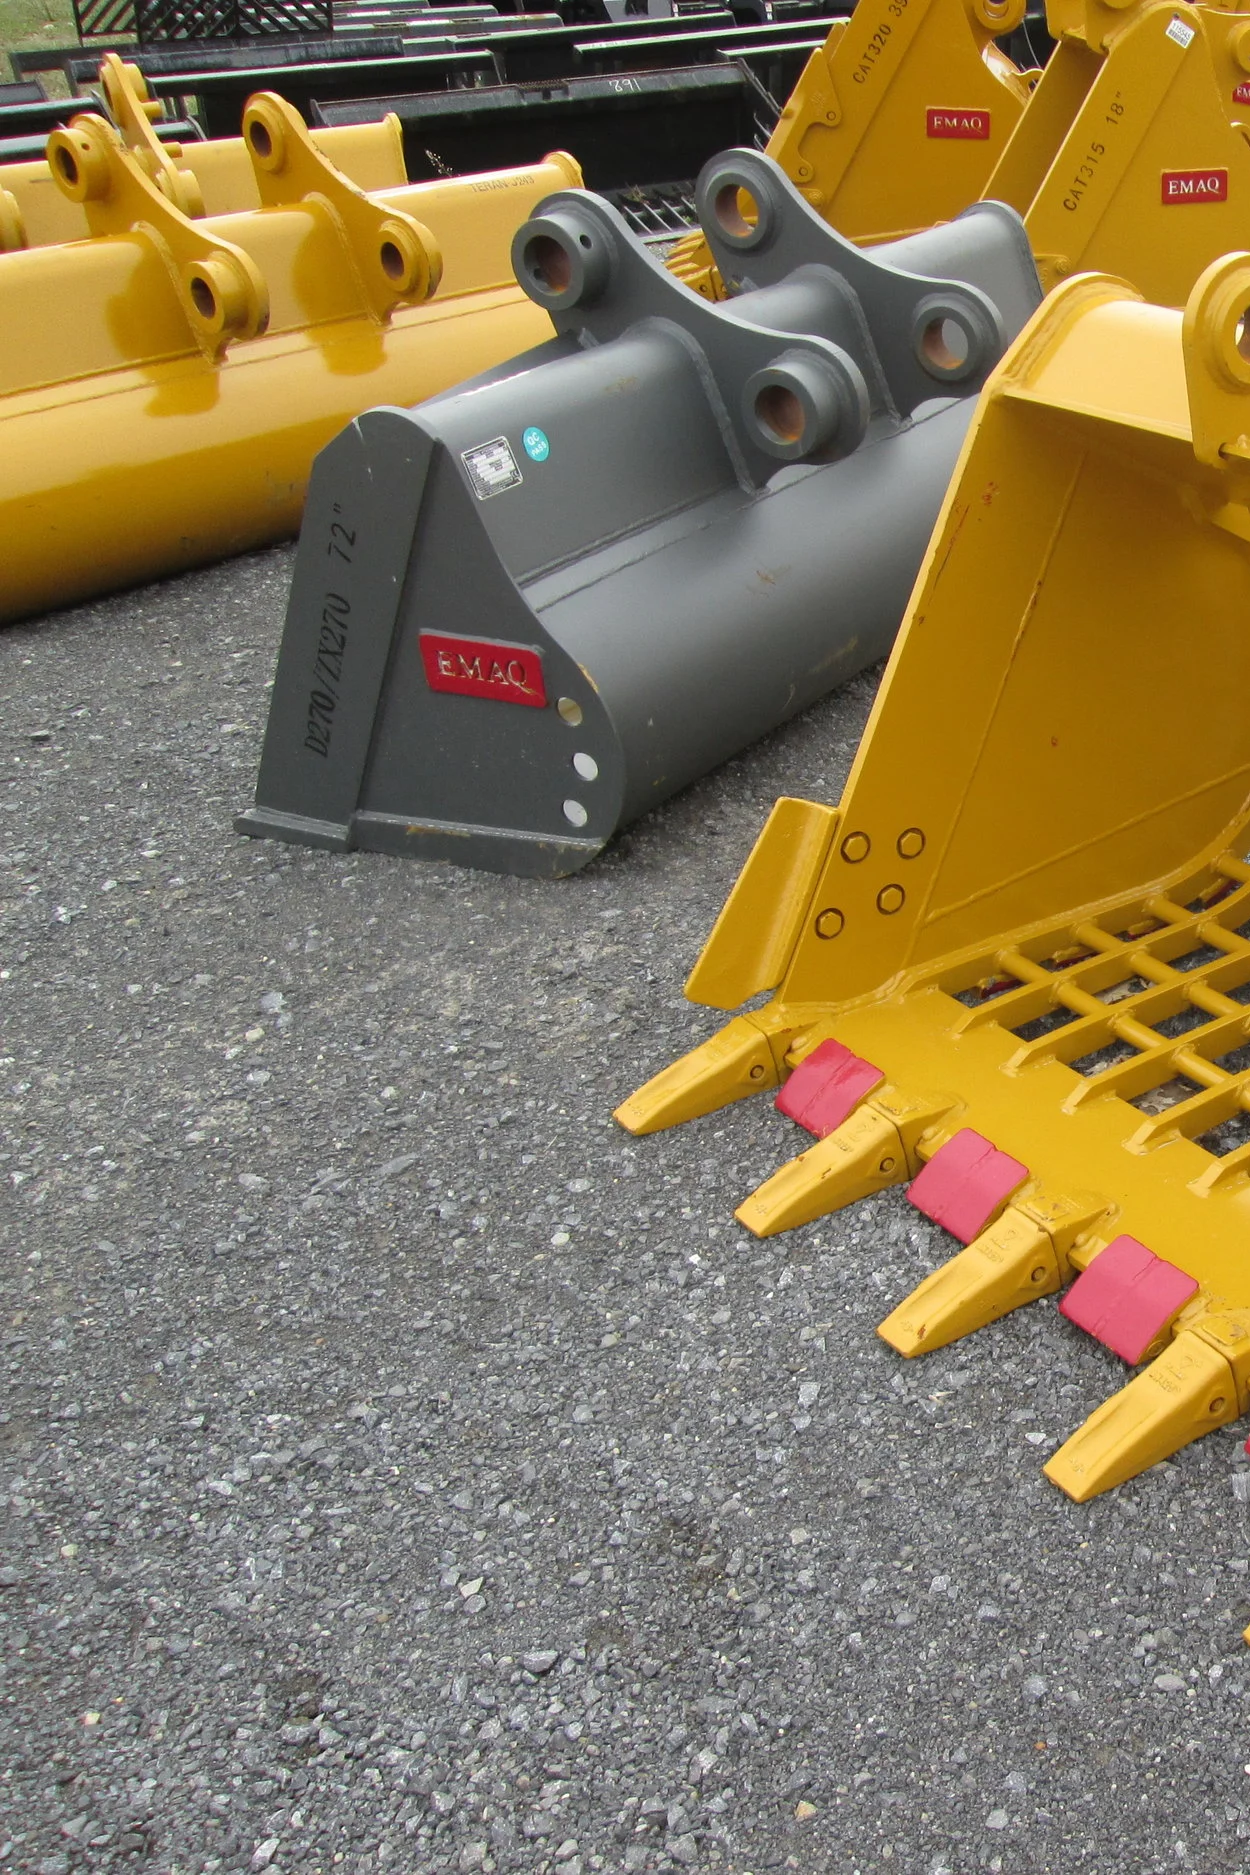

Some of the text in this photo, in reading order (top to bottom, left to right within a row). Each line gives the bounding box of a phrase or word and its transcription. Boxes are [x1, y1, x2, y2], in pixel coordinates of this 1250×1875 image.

[852, 23, 892, 84] CAT320
[933, 116, 984, 135] EMAQ
[1063, 91, 1125, 212] CAT315 18"
[1168, 177, 1220, 195] EMAQ
[527, 431, 540, 446] QC
[327, 502, 356, 563] 72"
[435, 651, 540, 696] EMAQ
